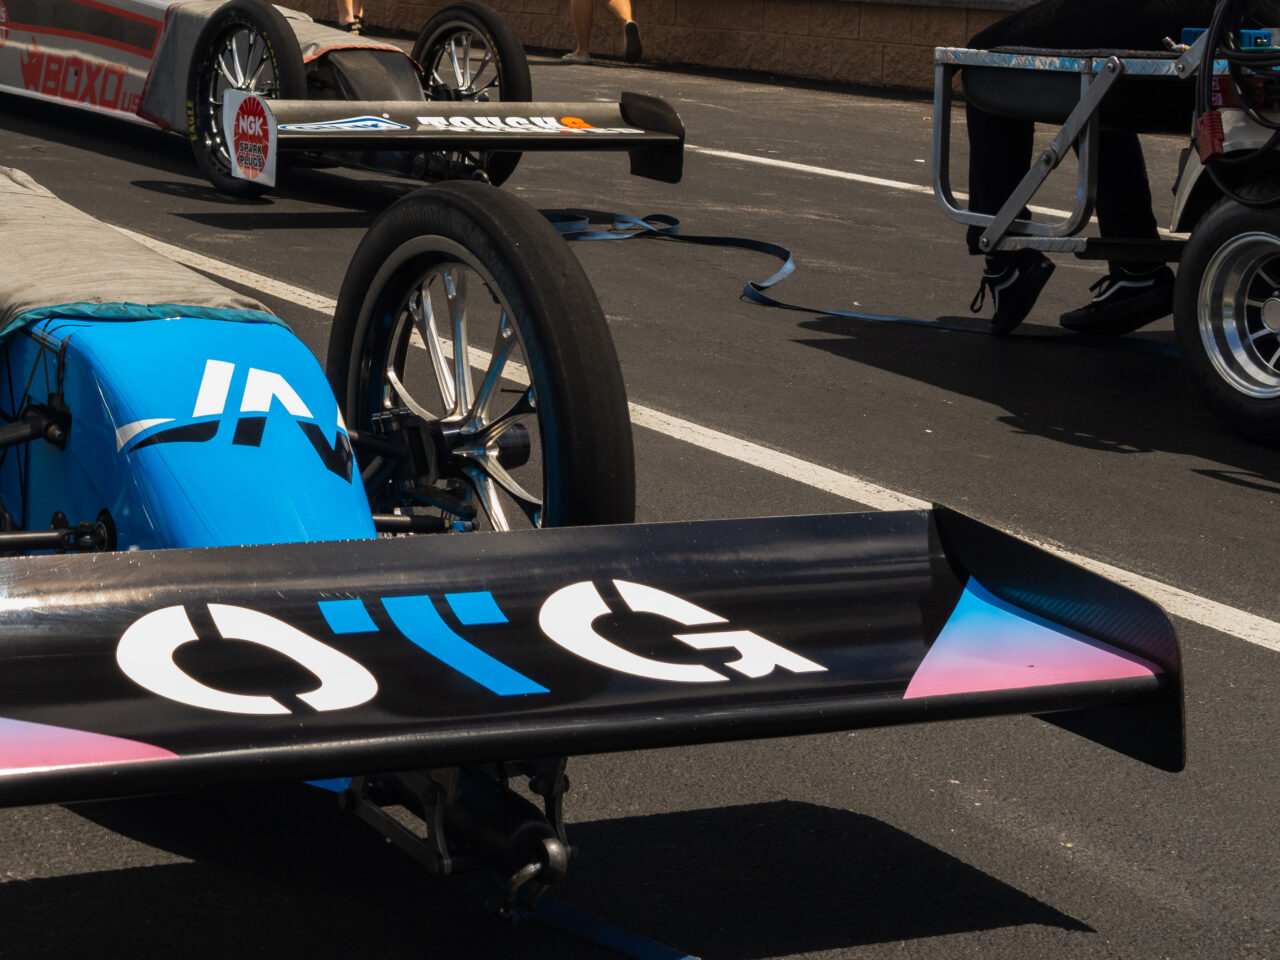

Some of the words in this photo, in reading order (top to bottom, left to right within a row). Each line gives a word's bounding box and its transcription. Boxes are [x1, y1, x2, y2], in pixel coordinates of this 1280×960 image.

[40, 53, 125, 111] BOXO
[239, 114, 264, 137] NGK
[239, 141, 263, 155] SPARK
[239, 154, 263, 168] PLUGS
